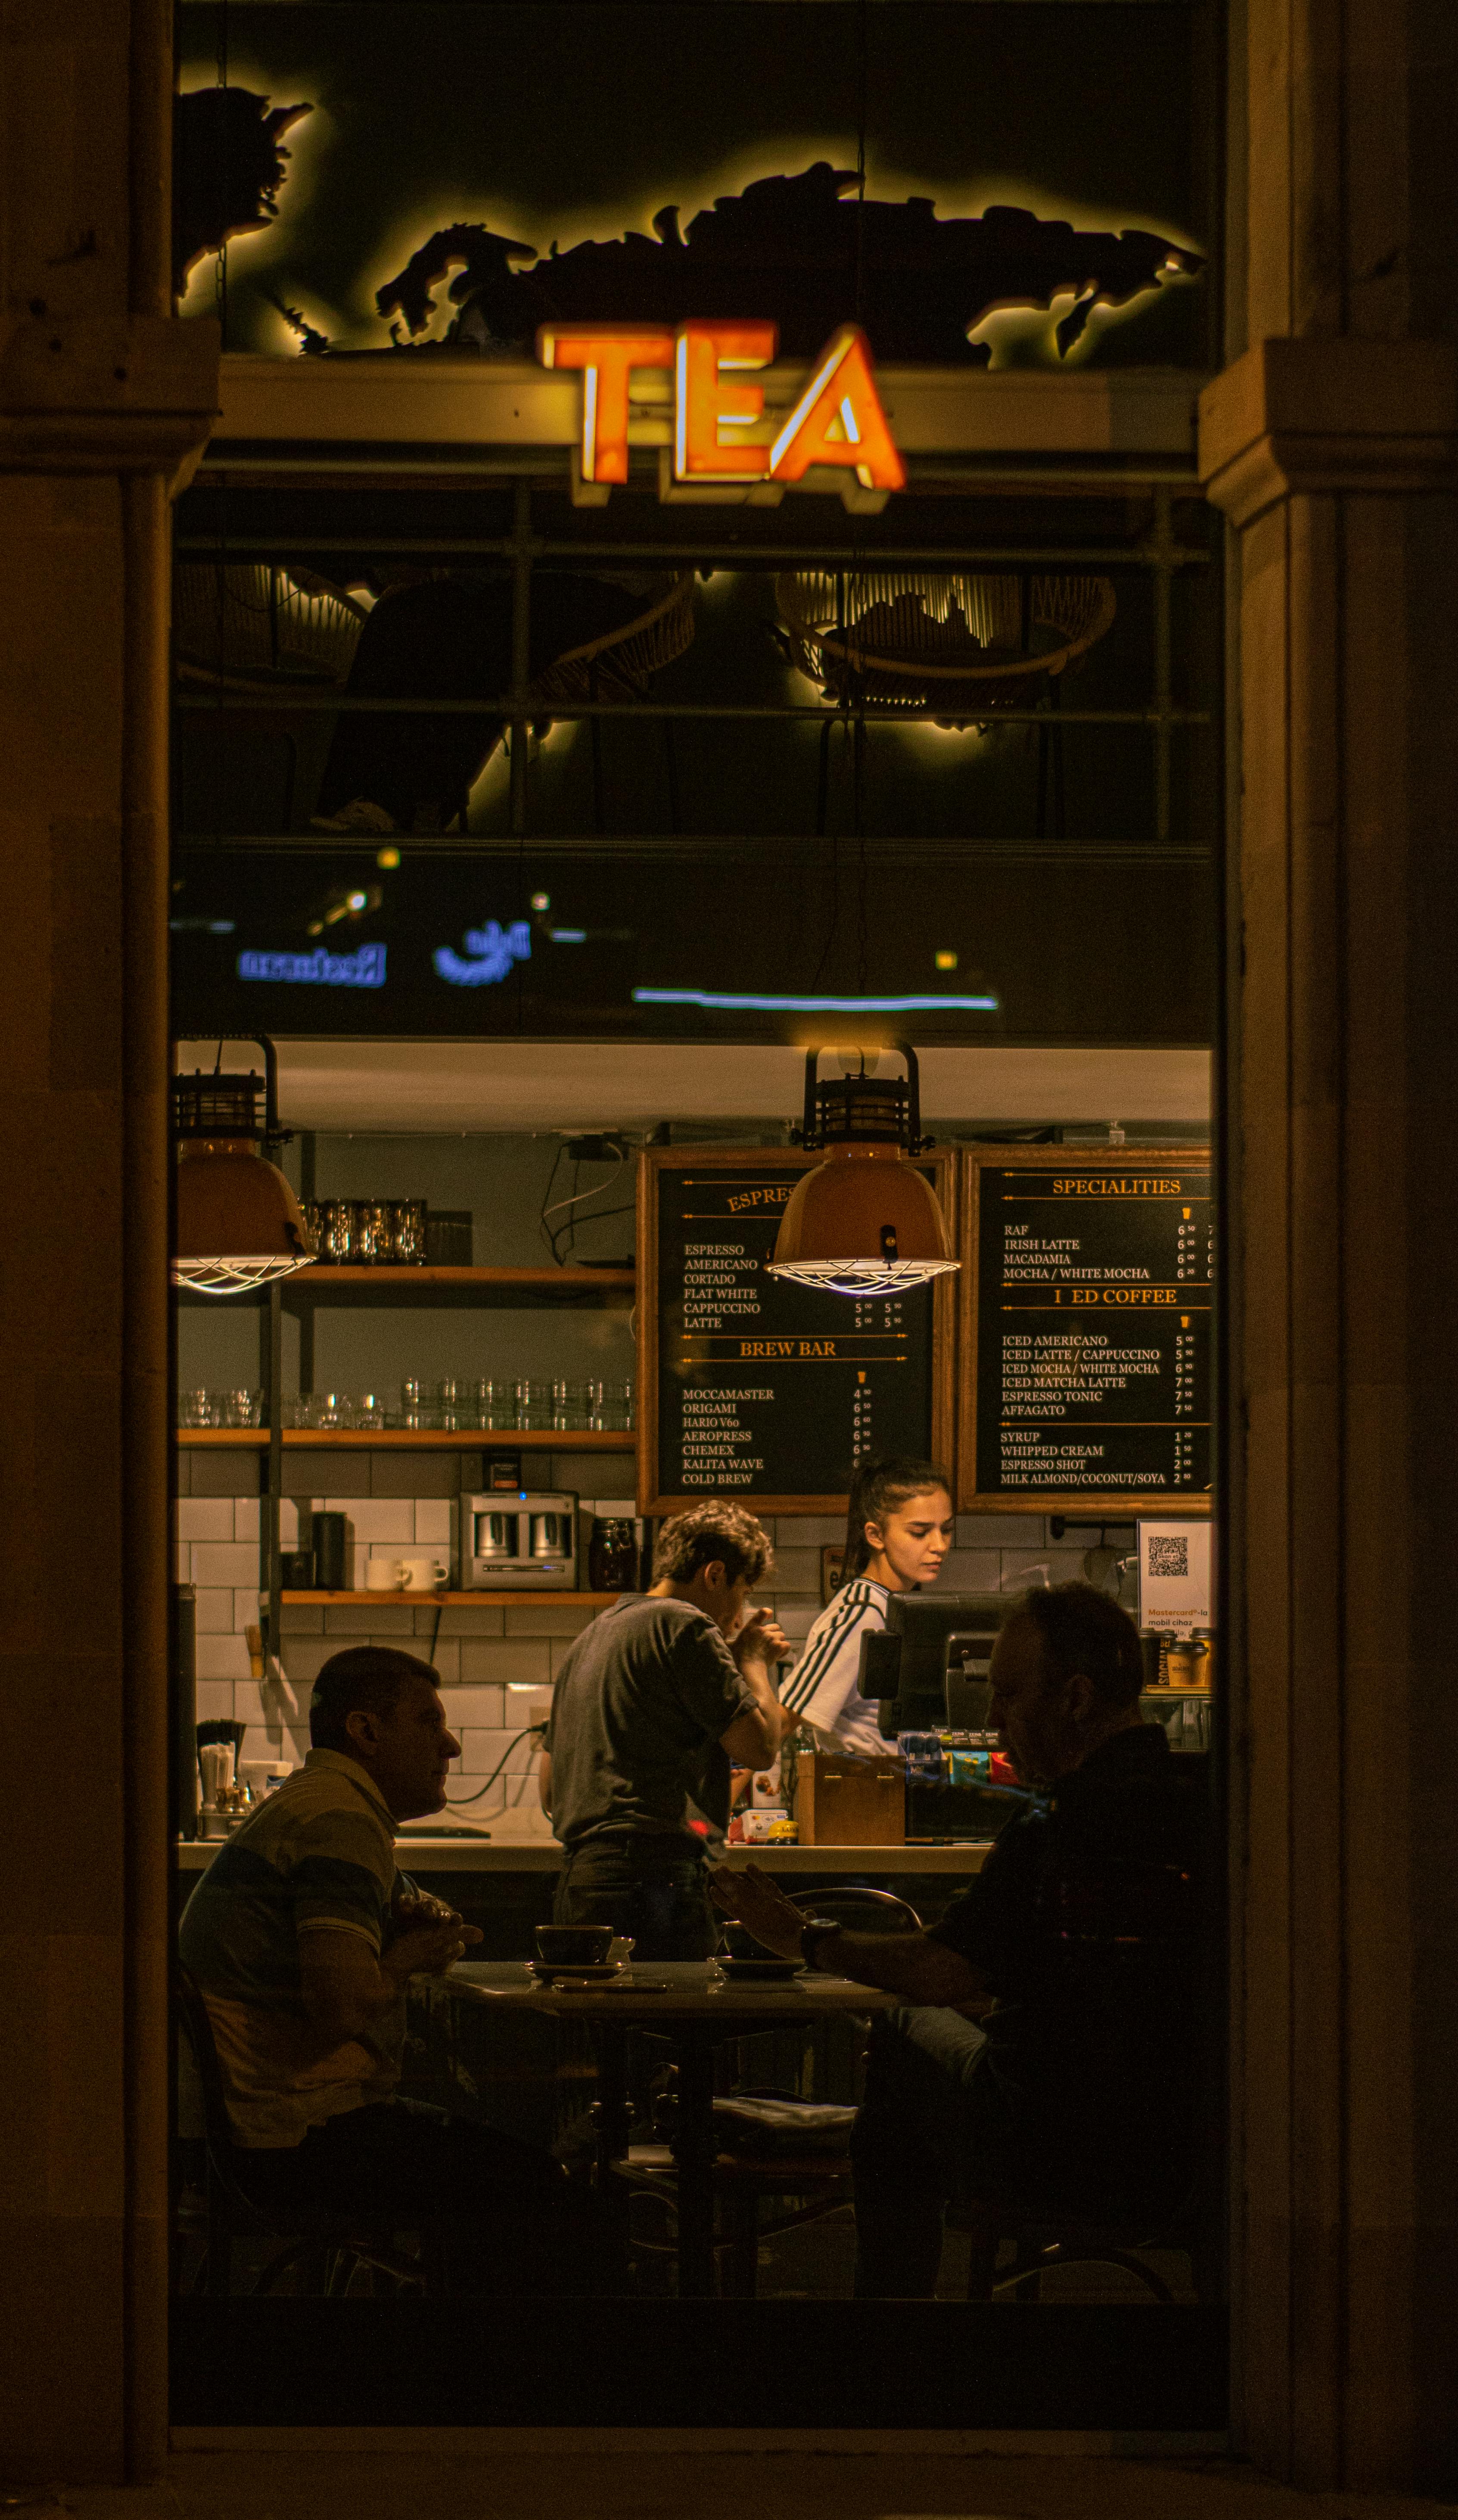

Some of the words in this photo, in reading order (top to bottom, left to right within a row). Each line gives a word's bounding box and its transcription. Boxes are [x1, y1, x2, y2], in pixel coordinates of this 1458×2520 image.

[538, 319, 906, 490] TEA
[1053, 1179, 1181, 1194] SPECIALITIES
[1004, 1225, 1029, 1235] RAF
[685, 1244, 744, 1255] ESPRESSO
[1005, 1240, 1038, 1250] IRISH
[1042, 1240, 1080, 1250] LATTE
[684, 1259, 758, 1270] AMERICANO
[1004, 1254, 1071, 1264] MACADAMIA
[1003, 1268, 1049, 1279] MOCHA
[1060, 1268, 1101, 1279] WHITE
[1104, 1268, 1150, 1279] MOCHA
[684, 1274, 736, 1285] CORTADO
[684, 1288, 714, 1299] FLAT
[716, 1288, 757, 1299] WHITE
[1103, 1289, 1177, 1303] COFFEE
[683, 1303, 761, 1314] CAPPUCCINO
[684, 1317, 721, 1328] LATTE
[1003, 1336, 1032, 1346] ICED
[1034, 1335, 1108, 1346] AMERICANO
[740, 1342, 794, 1356] BREW
[799, 1341, 836, 1356] BAR
[1002, 1350, 1032, 1360] ICED
[1034, 1350, 1072, 1360] LATTE
[1082, 1350, 1160, 1360] CAPPUCCINO
[1002, 1364, 1029, 1374] ICED
[1031, 1364, 1071, 1374] MOCHA
[1079, 1363, 1117, 1374] WHITE
[1119, 1363, 1160, 1374] MOCHA
[1002, 1378, 1032, 1388] ICED
[1034, 1377, 1086, 1388] MATCHA
[1088, 1377, 1126, 1388] LATTE
[683, 1389, 774, 1400] MOCCAMASTER
[1002, 1391, 1062, 1402] ESPRESSO
[1064, 1391, 1103, 1402] TONIC
[682, 1403, 736, 1414] ORIGAMI
[1001, 1405, 1066, 1416] AFFAGATO
[683, 1417, 718, 1428] HARIO
[719, 1417, 740, 1428] V60
[682, 1431, 752, 1441] AEROPRESS
[1001, 1432, 1040, 1442] SYRUP
[682, 1445, 734, 1455] CHEMEX
[1001, 1446, 1058, 1456] WHIPPED
[1060, 1446, 1103, 1456] CREAM
[683, 1459, 726, 1469] KALITA
[728, 1459, 763, 1469] WAVE
[1001, 1460, 1054, 1470] ESPRESSO
[1056, 1459, 1086, 1470] SHOT
[682, 1474, 715, 1484] COLD
[717, 1474, 752, 1484] BREW
[1001, 1474, 1029, 1484] MILK
[1030, 1473, 1166, 1485] ALMOND/COCONUT/SOYA
